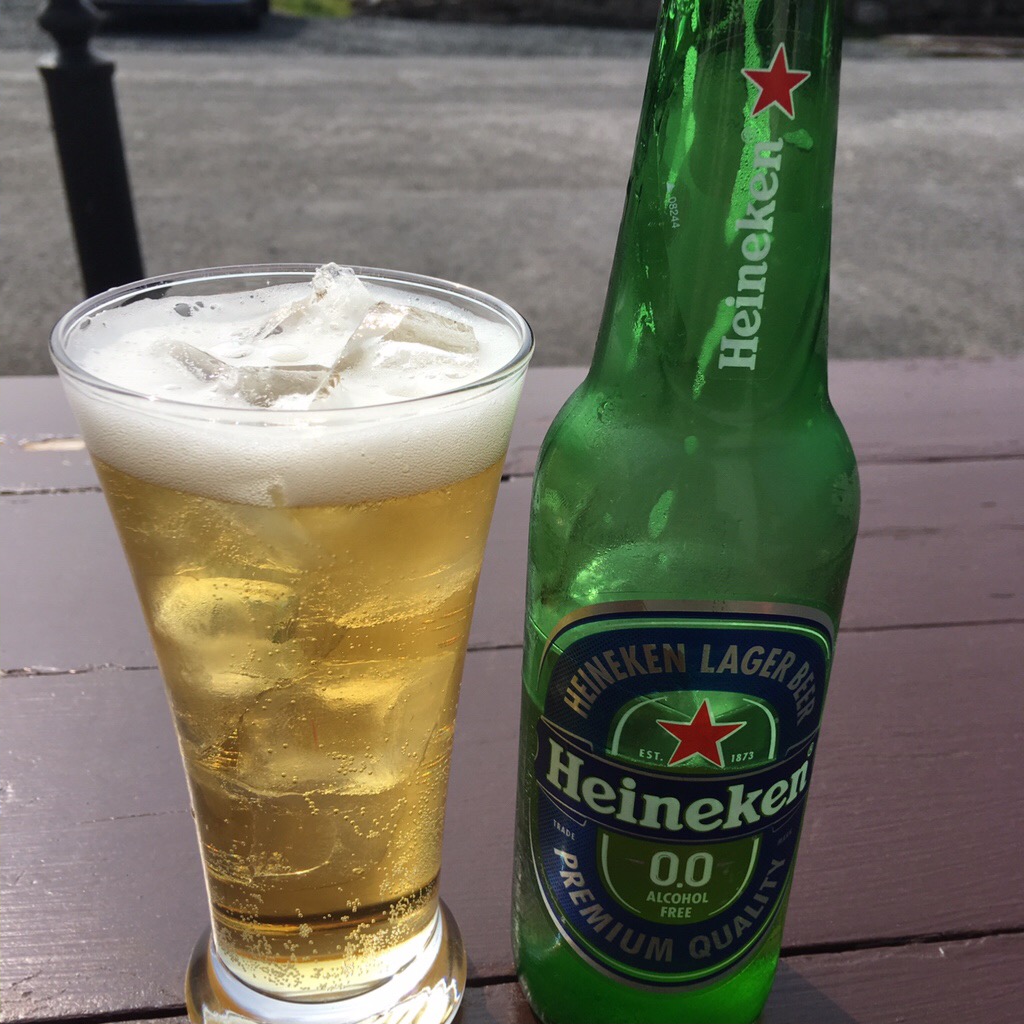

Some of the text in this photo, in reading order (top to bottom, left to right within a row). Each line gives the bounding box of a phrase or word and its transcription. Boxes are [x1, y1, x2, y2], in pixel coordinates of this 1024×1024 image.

[718, 137, 784, 371] Heineken
[563, 643, 817, 726] HEINEKEN LAGER BEER
[638, 749, 663, 762] EST.
[730, 750, 755, 763] 1873
[545, 738, 809, 833] Heineken
[553, 819, 576, 841] TRADE
[649, 850, 714, 889] 0.0
[553, 847, 787, 963] PREMIUM QUALITY
[645, 891, 709, 904] ALCOHOL
[660, 906, 692, 919] FREE
